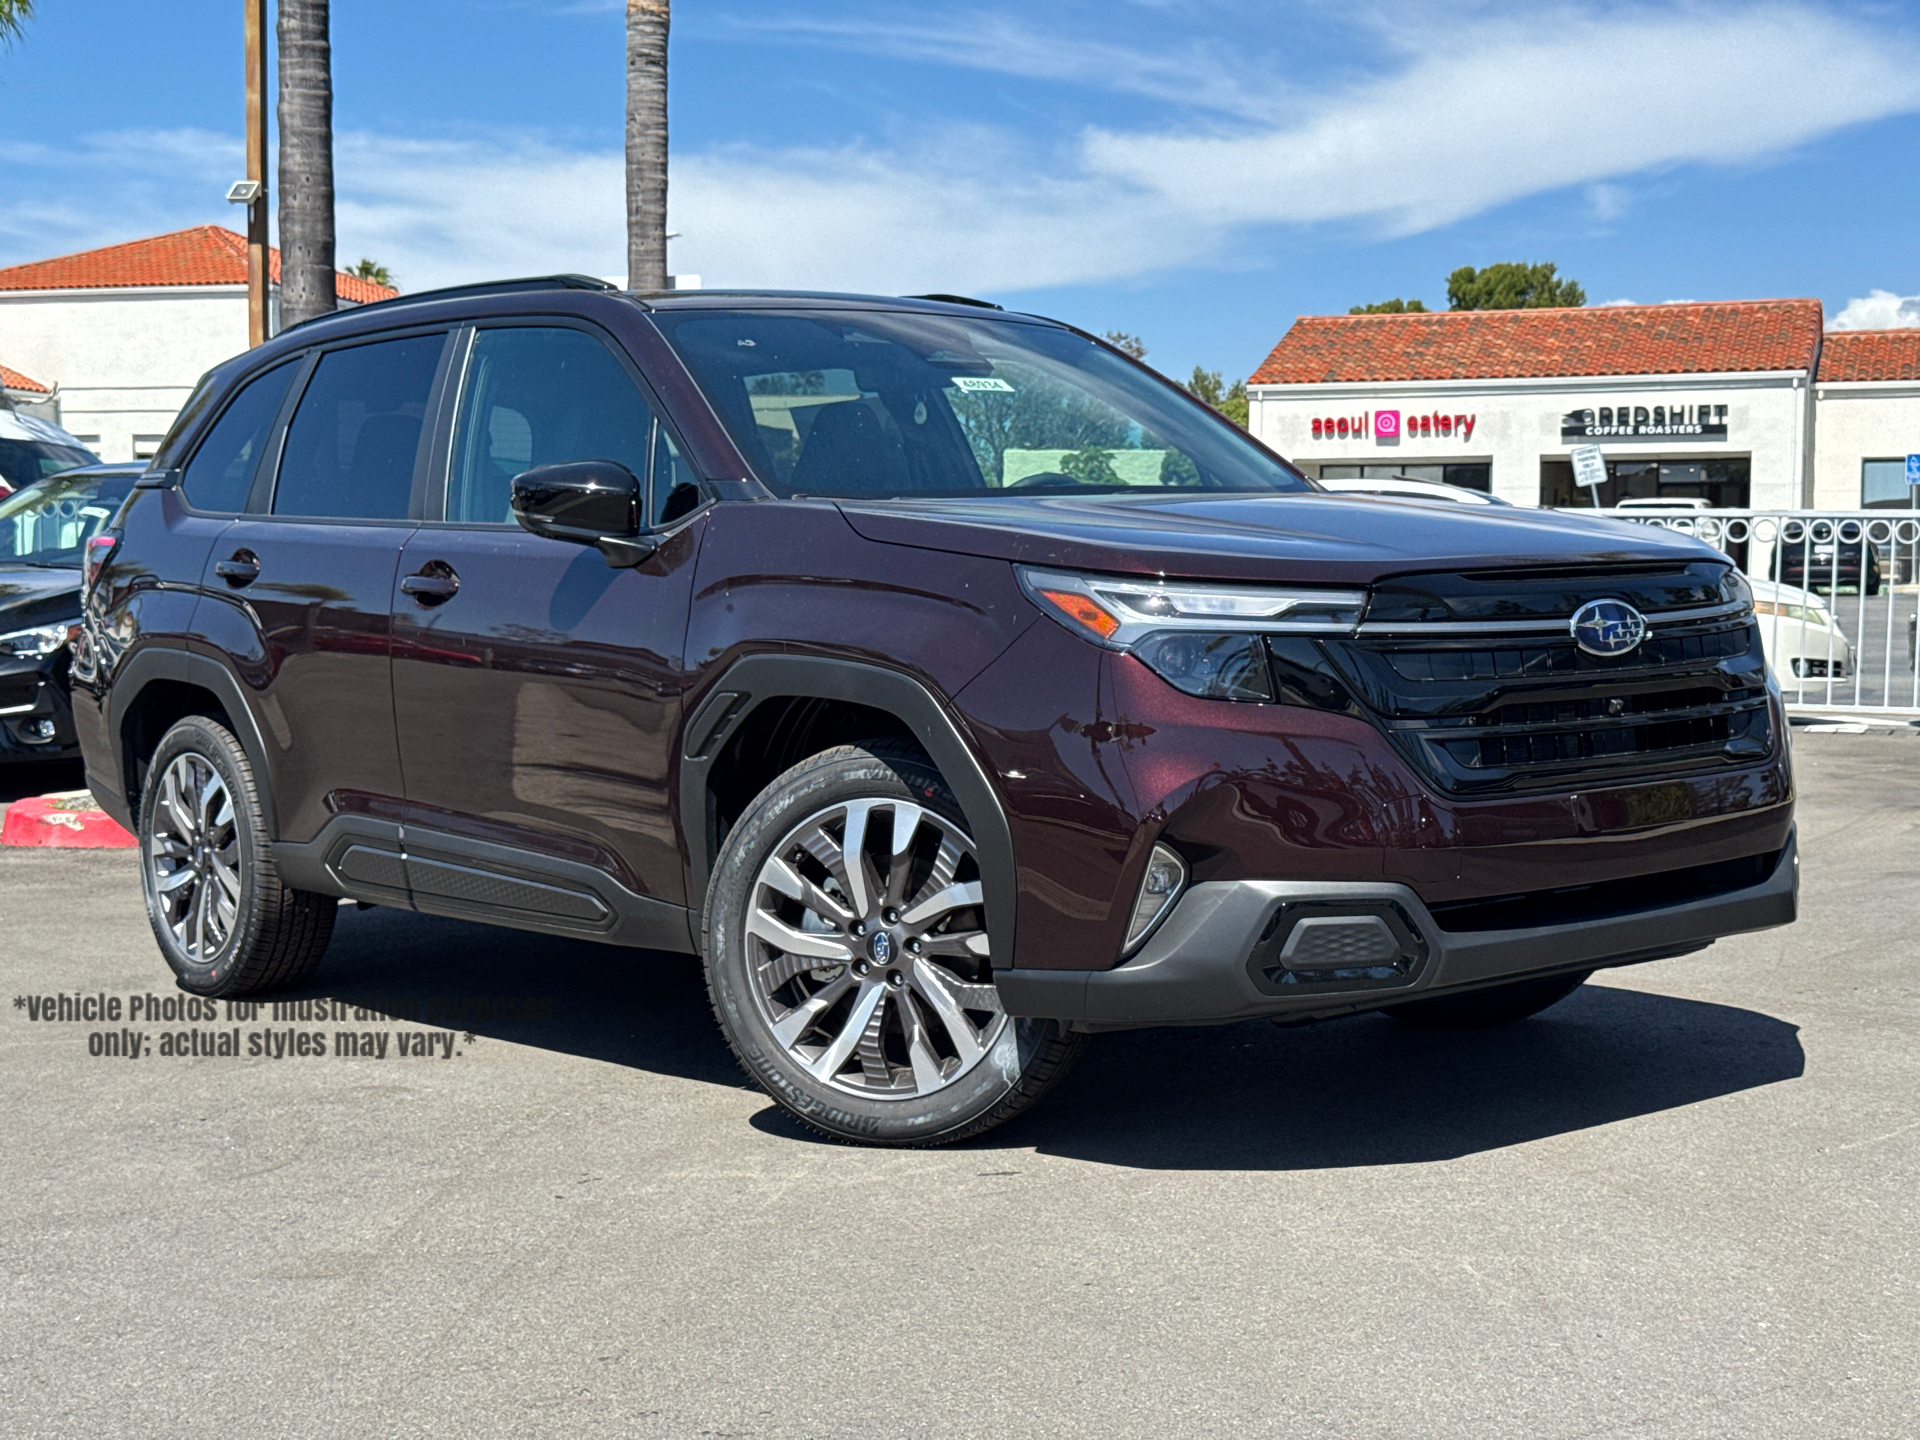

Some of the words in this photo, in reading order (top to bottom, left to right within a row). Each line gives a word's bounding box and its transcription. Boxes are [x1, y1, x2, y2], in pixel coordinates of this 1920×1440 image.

[1311, 411, 1369, 437] seoul
[1407, 410, 1476, 441] eatery
[1599, 404, 1728, 426] REDSHIFT
[1585, 426, 1635, 436] COFFEE
[1638, 424, 1703, 435] ROASTERS
[748, 1043, 882, 1135] BRIDGESTONE
